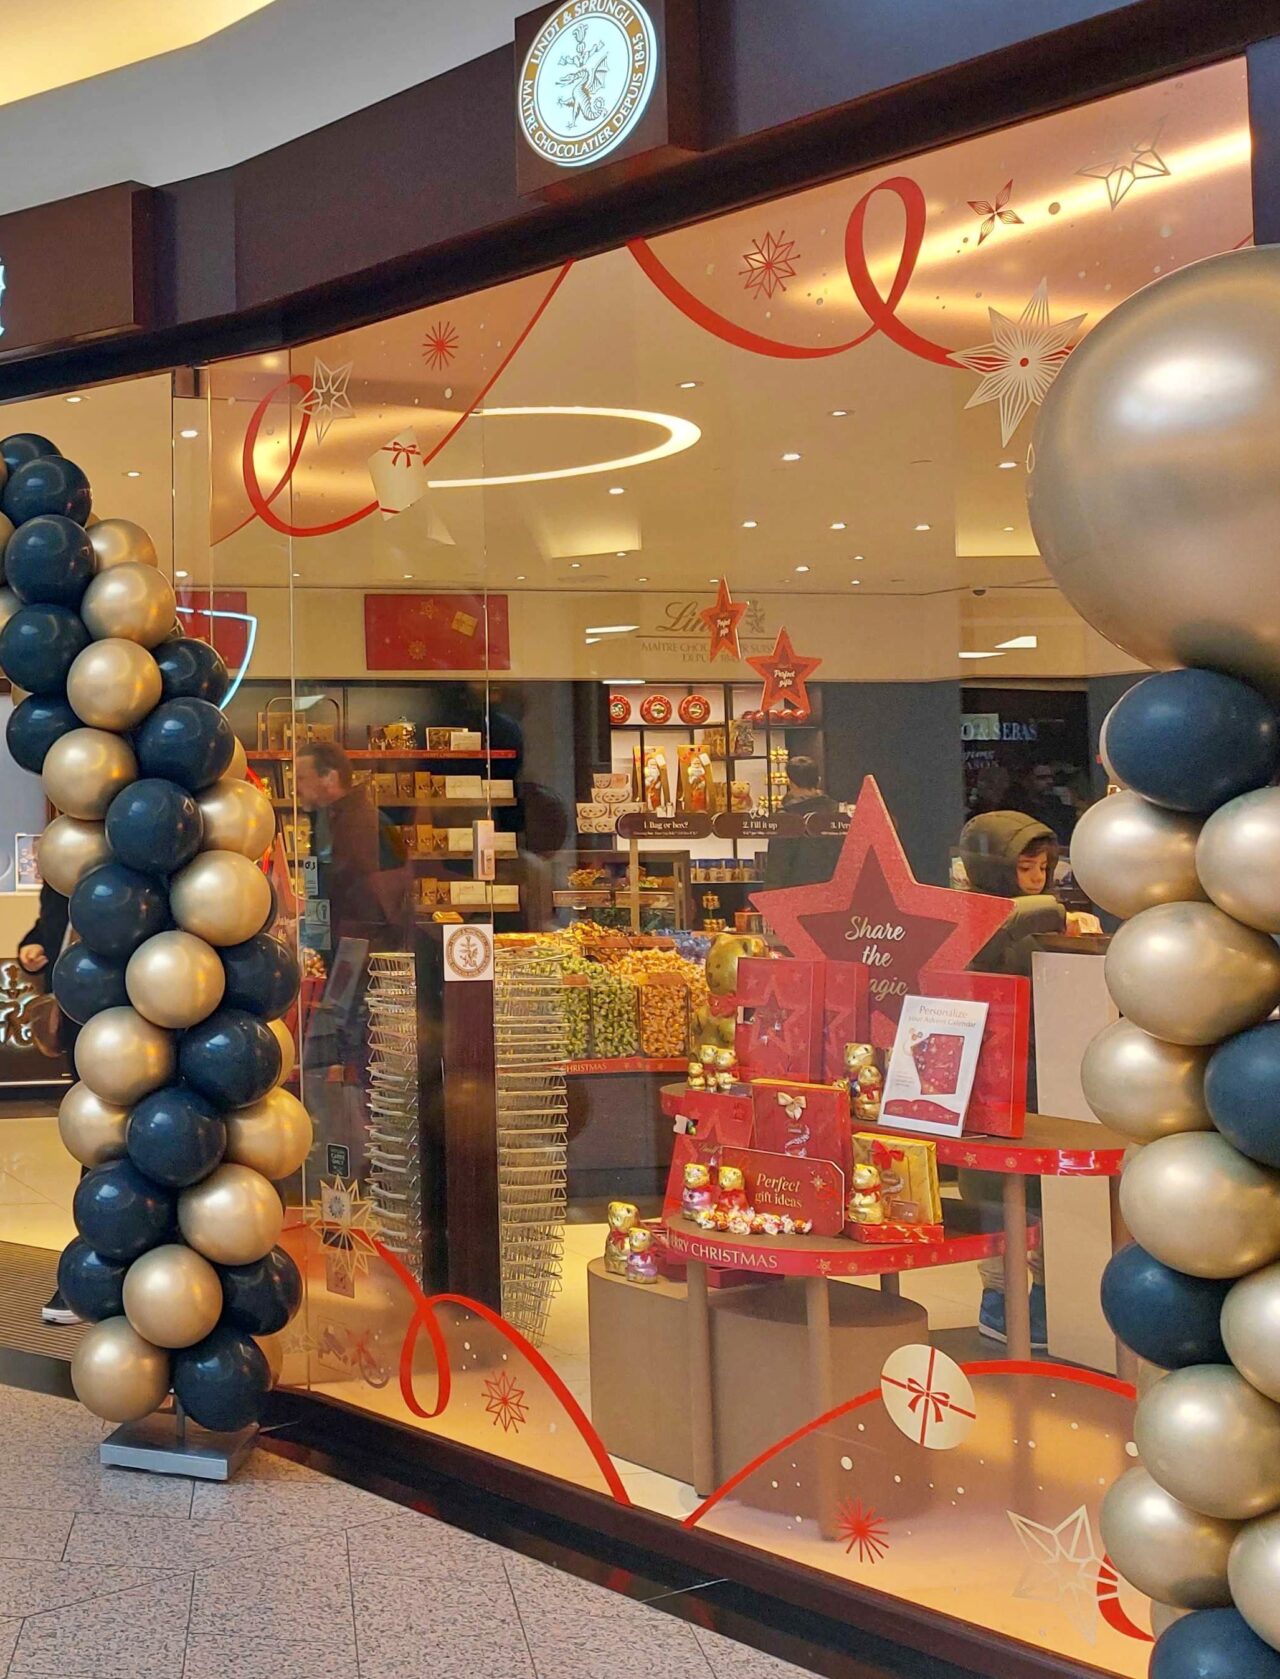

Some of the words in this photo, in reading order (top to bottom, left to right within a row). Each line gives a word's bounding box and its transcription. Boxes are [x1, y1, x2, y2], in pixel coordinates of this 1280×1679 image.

[531, 23, 561, 65] LINDT
[562, 12, 574, 25] &
[535, 127, 614, 158] CHOCOLATIER
[613, 73, 644, 127] DEPUIS
[632, 33, 645, 68] 1845
[656, 601, 711, 632] Lin
[774, 669, 795, 680] Perfect
[844, 915, 906, 941] Share
[862, 944, 894, 967] the
[870, 976, 909, 1001] agic
[919, 1004, 969, 1019] Personalize
[947, 1018, 977, 1028] Calendar
[566, 1062, 608, 1073] HRISTMAS
[756, 1172, 800, 1193] Perfect
[755, 1190, 771, 1205] gift
[774, 1193, 802, 1208] ideas
[691, 1242, 779, 1270] CHRISTMAS
